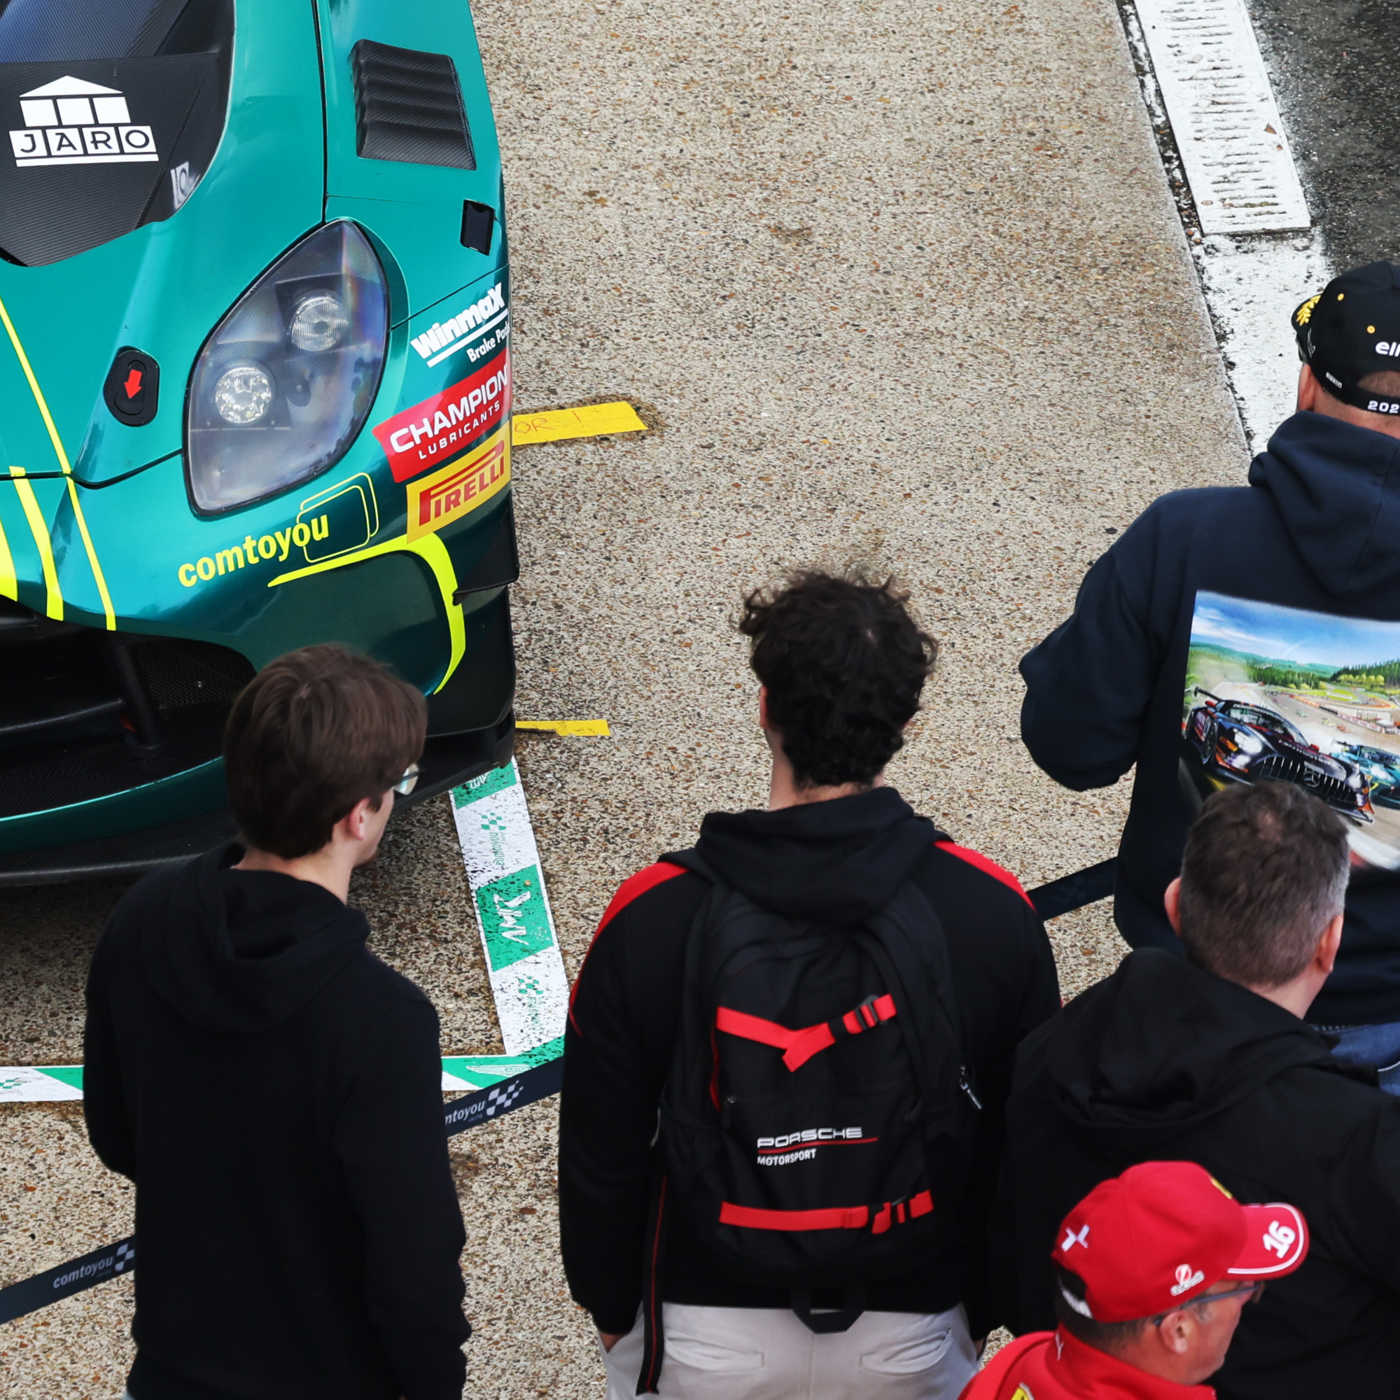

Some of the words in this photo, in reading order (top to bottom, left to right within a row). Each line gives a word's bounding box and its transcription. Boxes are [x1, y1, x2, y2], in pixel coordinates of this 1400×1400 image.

[17, 127, 152, 154] JARO
[411, 282, 506, 361] Winmax
[466, 336, 496, 363] Brake
[390, 364, 511, 455] CHAMPION
[418, 402, 501, 460] LUBRICANTS
[418, 439, 505, 527] PIRELLI
[178, 513, 330, 588] comtoyou
[756, 1127, 863, 1150] PORSCHE
[756, 1149, 817, 1167] MOTORSPORT
[1263, 1221, 1295, 1259] 16
[52, 1254, 113, 1290] comtoyou
